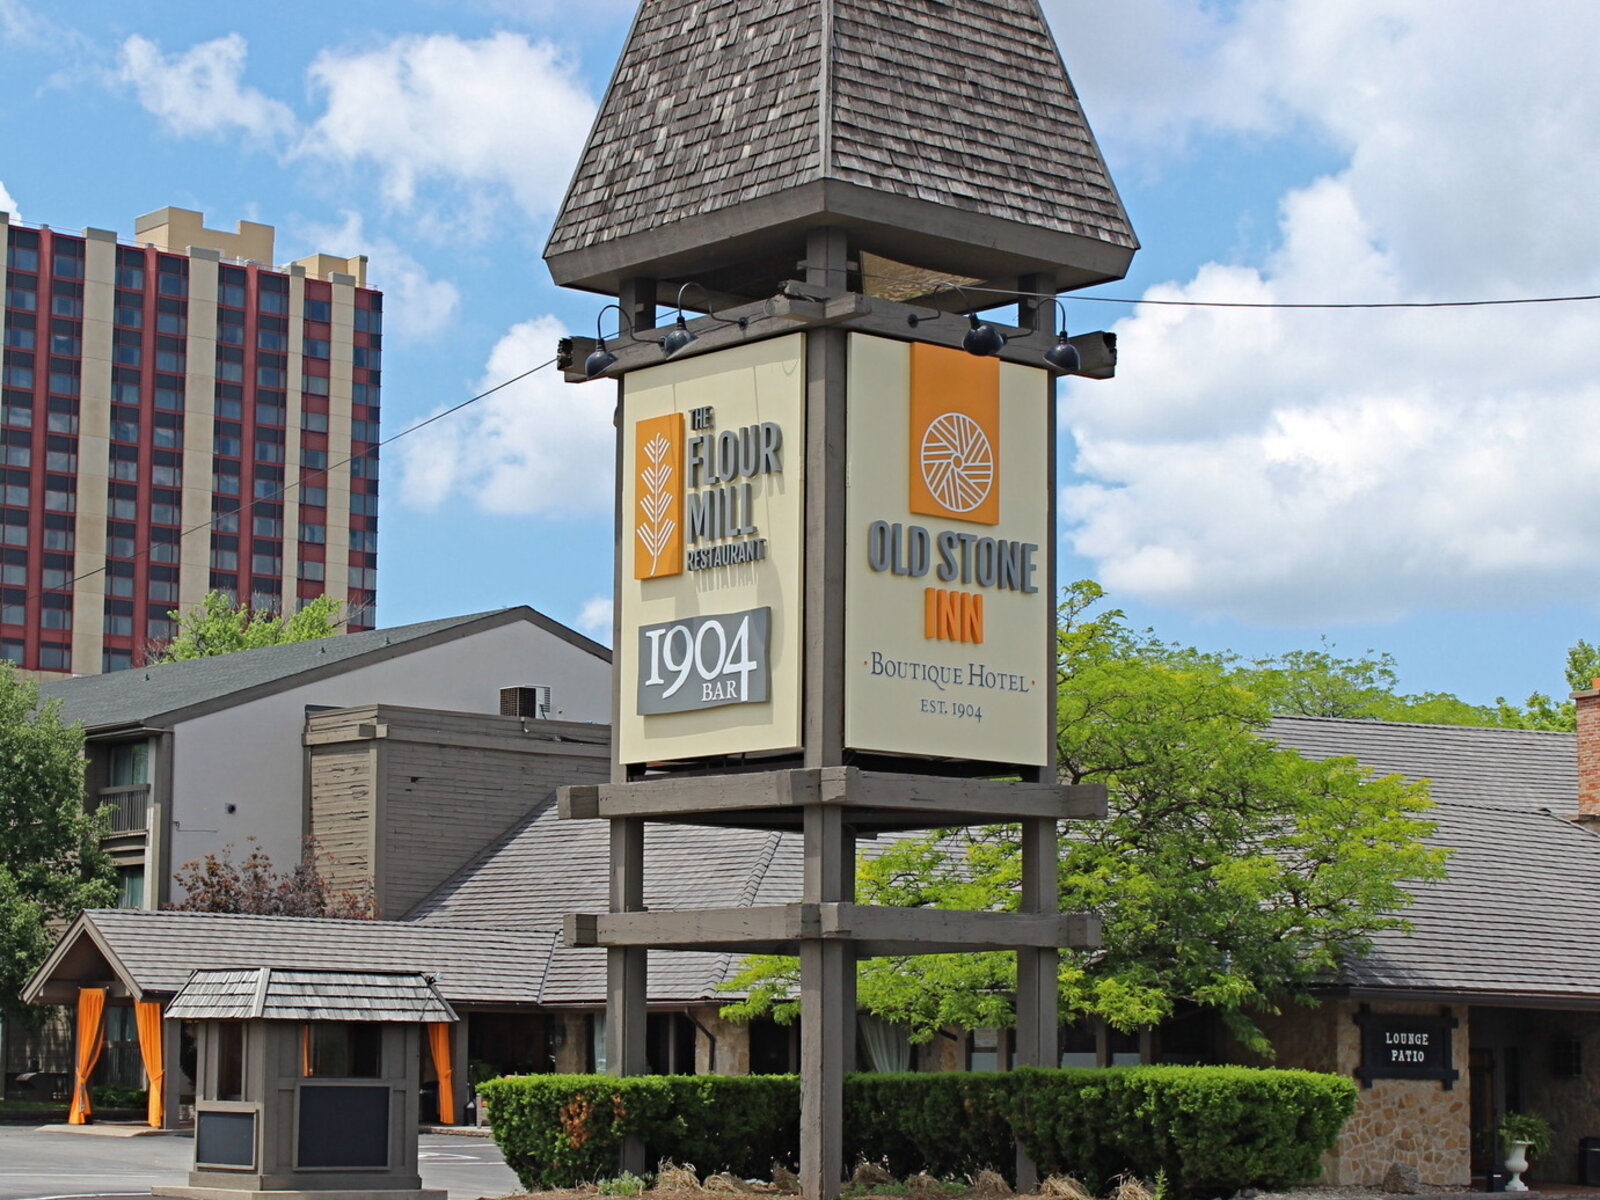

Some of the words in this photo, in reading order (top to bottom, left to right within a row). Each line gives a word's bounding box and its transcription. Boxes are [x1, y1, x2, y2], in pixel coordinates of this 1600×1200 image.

[688, 405, 714, 431] THE
[688, 422, 783, 488] FLOUR
[687, 483, 758, 544] MILL
[687, 538, 767, 571] RESTAURANT
[868, 520, 930, 577] OLD
[937, 531, 1039, 594] STONE
[924, 587, 983, 644] INN
[645, 615, 757, 702] 1904
[871, 651, 963, 691] BOUTIQUE
[968, 663, 1029, 693] HOTEL
[701, 680, 738, 702] BAR
[921, 699, 948, 714] EST.
[952, 702, 982, 723] 1904
[1385, 1032, 1429, 1045] LOUNGE
[1391, 1049, 1424, 1062] PATIO
